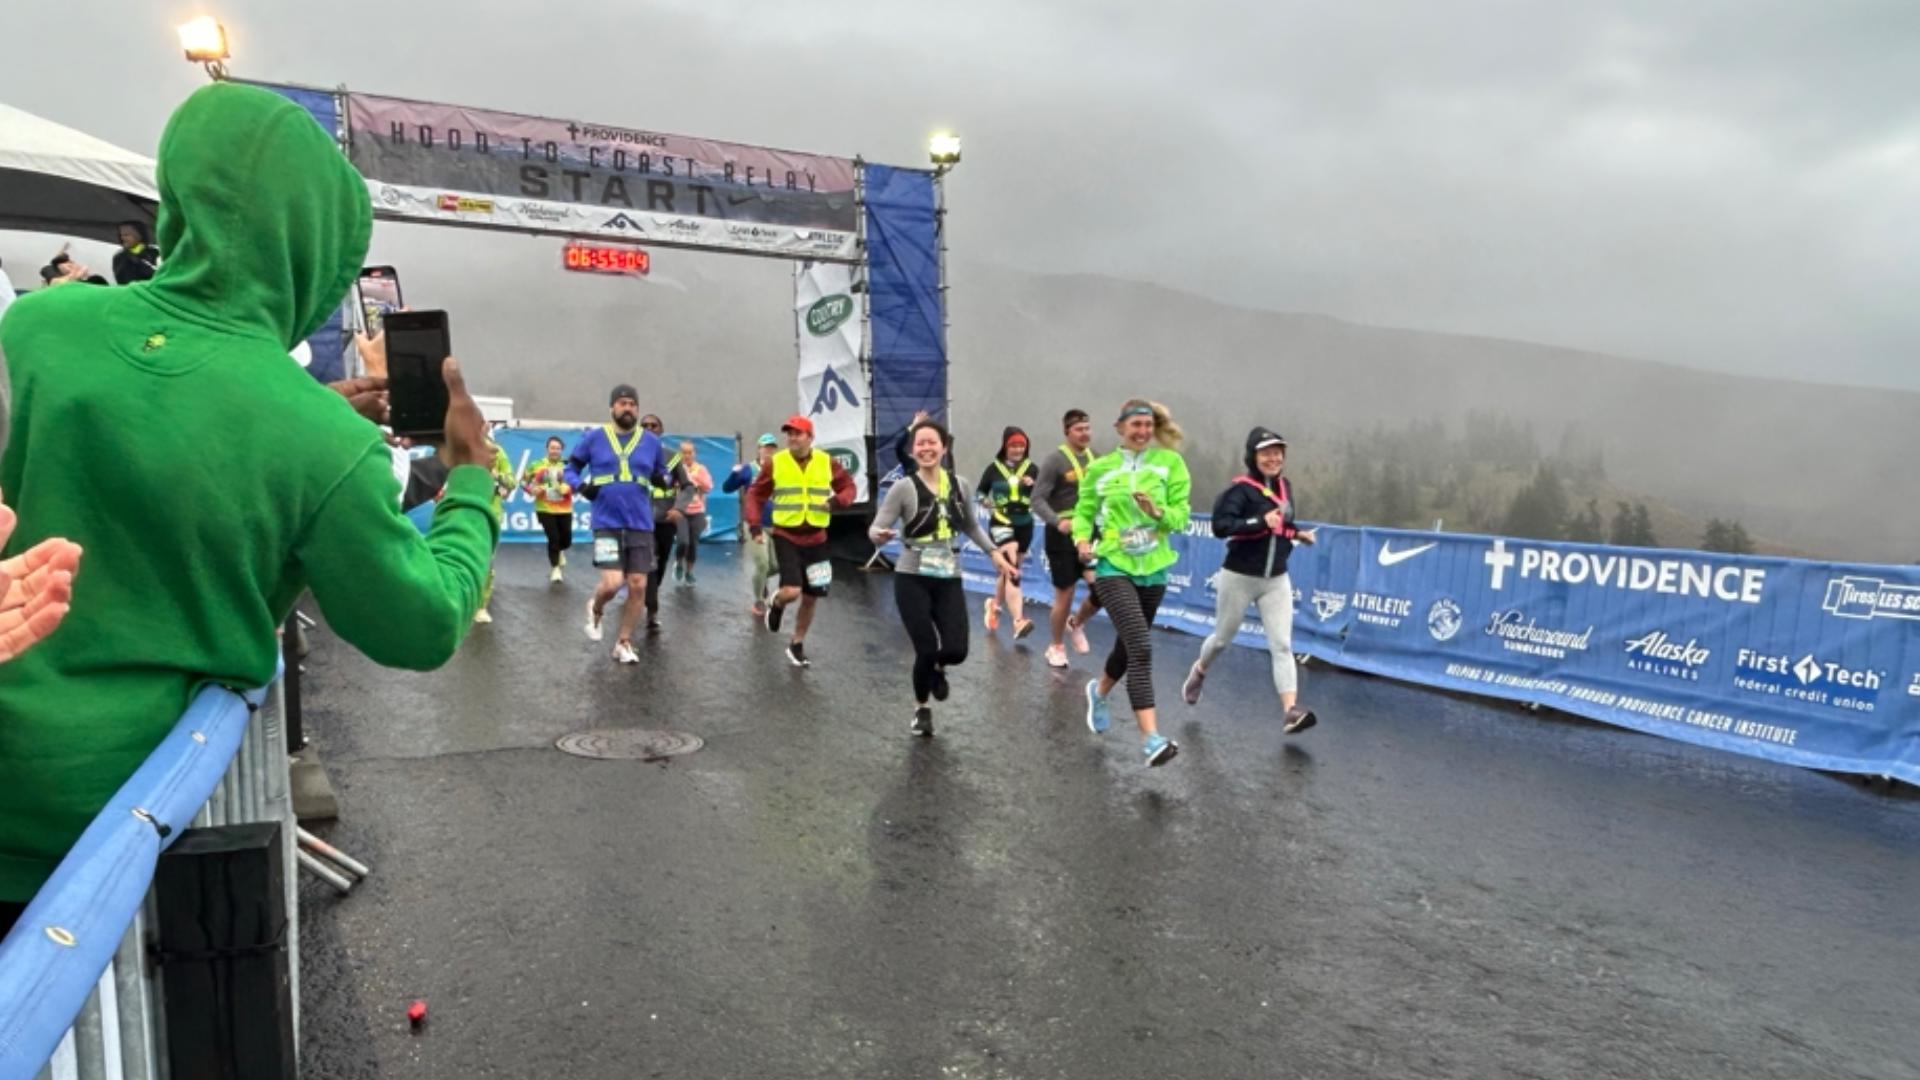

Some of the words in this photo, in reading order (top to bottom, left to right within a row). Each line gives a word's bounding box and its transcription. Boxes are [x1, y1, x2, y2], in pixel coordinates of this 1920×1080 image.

[583, 126, 667, 147] PROVIDENCE
[391, 120, 488, 155] HOOD
[521, 137, 558, 164] TO
[590, 146, 695, 180] COAST
[724, 161, 815, 192] RELAY
[520, 164, 714, 215] START
[568, 246, 648, 272] 06:55:04
[1520, 548, 1766, 603] PROVIDENCE
[1351, 592, 1412, 617] ATHLETIC
[1842, 582, 1876, 606] Tires
[1878, 593, 1904, 609] LES
[1504, 640, 1565, 659] SUNGLASSES
[1624, 630, 1711, 666] Alaska
[1628, 659, 1698, 681] AIRLINES
[1737, 648, 1789, 675] First
[1823, 663, 1880, 690] Tech
[1446, 663, 1482, 681] HELPING
[1481, 671, 1495, 683] TO
[1617, 696, 1686, 721] PROVIDENCE
[1686, 709, 1734, 732] CANCER
[1734, 719, 1797, 746] INSTITUTE
[1733, 676, 1780, 694] federal
[1784, 687, 1828, 704] credit
[1832, 697, 1875, 712] union
